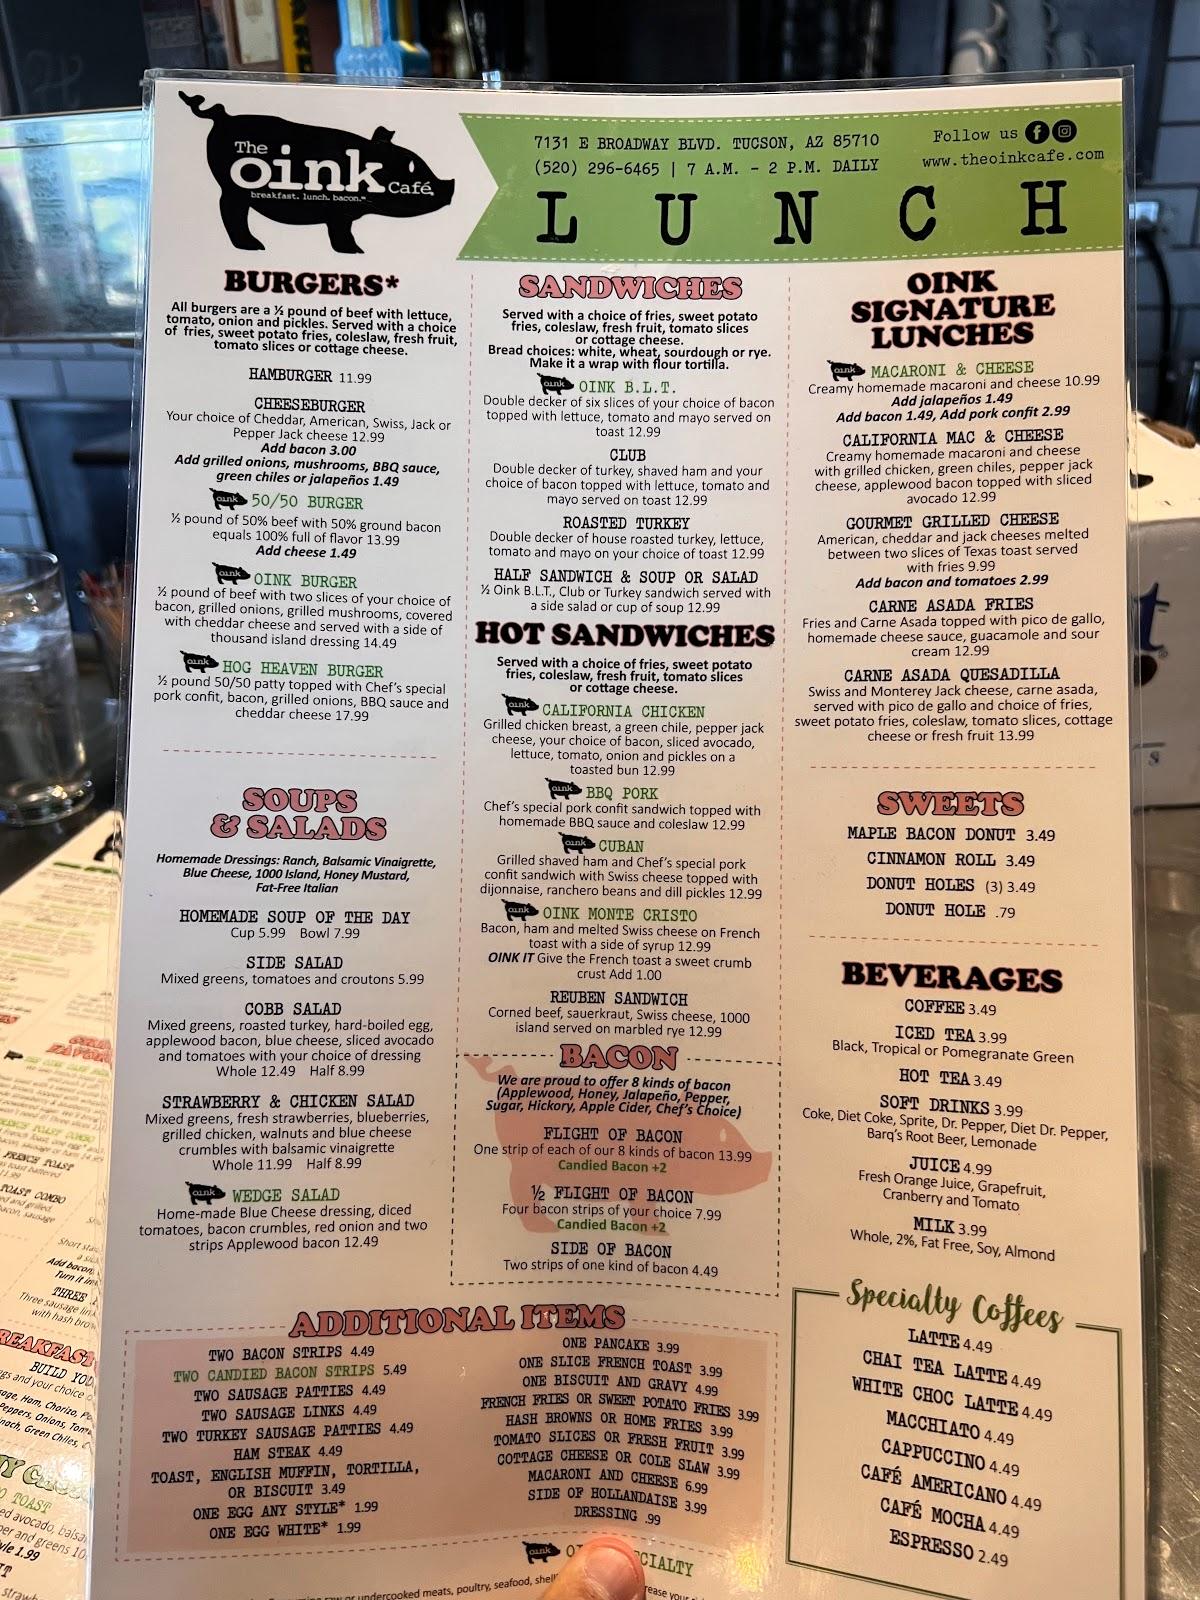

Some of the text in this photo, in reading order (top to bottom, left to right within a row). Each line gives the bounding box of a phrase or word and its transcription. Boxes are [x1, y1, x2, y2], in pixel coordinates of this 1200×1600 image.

[534, 134, 879, 151] 7131 E BROADWAY BLVD. TUCSON, AZ 85710
[933, 129, 1018, 142] Follow us
[235, 141, 268, 154] The
[535, 158, 880, 176] (520) 296-6465 7 A.M. 2 P.M. DAILY
[922, 149, 1104, 168] www.theoinkcafe.com
[230, 144, 386, 193] oink
[251, 191, 299, 200] breakfast.
[303, 193, 330, 201] lunch.
[518, 275, 743, 300] SANDWICHES
[907, 270, 998, 295] OINK
[851, 293, 1056, 323] SIGNATURE
[871, 322, 1034, 349] LUNCHES
[249, 367, 372, 384] HAMBURGER 11.99
[871, 360, 1034, 378] MACARONI & CHEESE
[579, 381, 676, 394] OINK B.L.T.
[254, 397, 366, 413] CHEESEBURGER
[890, 392, 1013, 409] Add jalapeños 1.49
[842, 428, 1064, 447] CALIFORNIA MAC & CHEESE
[260, 442, 357, 457] Add bacon 3.00
[251, 493, 298, 509] 50/50
[307, 496, 364, 510] BURGER
[562, 516, 690, 530] ROASTED TURKEY
[254, 573, 358, 589] OINK BURGER
[494, 568, 759, 585] HALF SANDWICH & SOUP OR SALAD
[474, 620, 775, 648] HOT SANDWICHES
[222, 660, 384, 678] HOG HEAVEN BURGER
[844, 667, 1061, 683] CARNE ASADA QUESADILLA
[172, 676, 210, 689] pound
[214, 677, 251, 690] 50/50
[254, 680, 286, 692] patty
[289, 680, 332, 693] topped
[335, 681, 362, 692] with
[405, 684, 446, 696] special
[542, 703, 705, 719] CALIFORNIA CHICKEN
[242, 787, 358, 813] SOUPS
[586, 786, 659, 800] BBQ PORK
[877, 791, 1025, 816] SWEETS
[210, 813, 387, 841] & SALADS
[847, 826, 1056, 842] MAPLE BACON DONUT 3.49
[598, 840, 644, 853] CUBAN
[180, 909, 411, 925] HOMEMADE SOUP OF THE DAY
[543, 907, 698, 922] OINK MONTE CRISTO
[841, 962, 1063, 993] BEVERAGES
[904, 999, 997, 1016] COFFEE 3.49
[895, 1025, 1007, 1044] ICED TEA 3.99
[559, 1043, 679, 1071] BACON
[161, 1094, 415, 1110] STRAWBERRY & CHICKEN SALAD
[543, 1127, 684, 1144] FLIGHT OF BACON
[232, 1187, 340, 1202] WEDGE SALAD
[557, 1218, 667, 1233] Candied Bacon +2
[19, 1292, 80, 1314] Three sausage
[51, 1286, 88, 1303] THREE
[846, 1278, 1064, 1334] Specialty Coffees
[288, 1304, 626, 1338] ADDITIONAL ITEMS
[562, 1337, 680, 1354] ONE PANCAKE 3.99
[907, 1328, 993, 1354] LATTE 4.49
[208, 1346, 375, 1362] TWO BACON STRIPS 4.49
[29, 1361, 68, 1379] BUILD
[20, 1393, 78, 1418] Ham, Chorizo,
[24, 1425, 79, 1449] Green Chiles,
[861, 1464, 1042, 1512] CAFÉ AMERICANO 4.49
[13, 1512, 55, 1535] avocado,
[888, 1528, 1009, 1567] ESPRESSO 2.49
[423, 1576, 533, 1598] meats, poultry, seafood,
